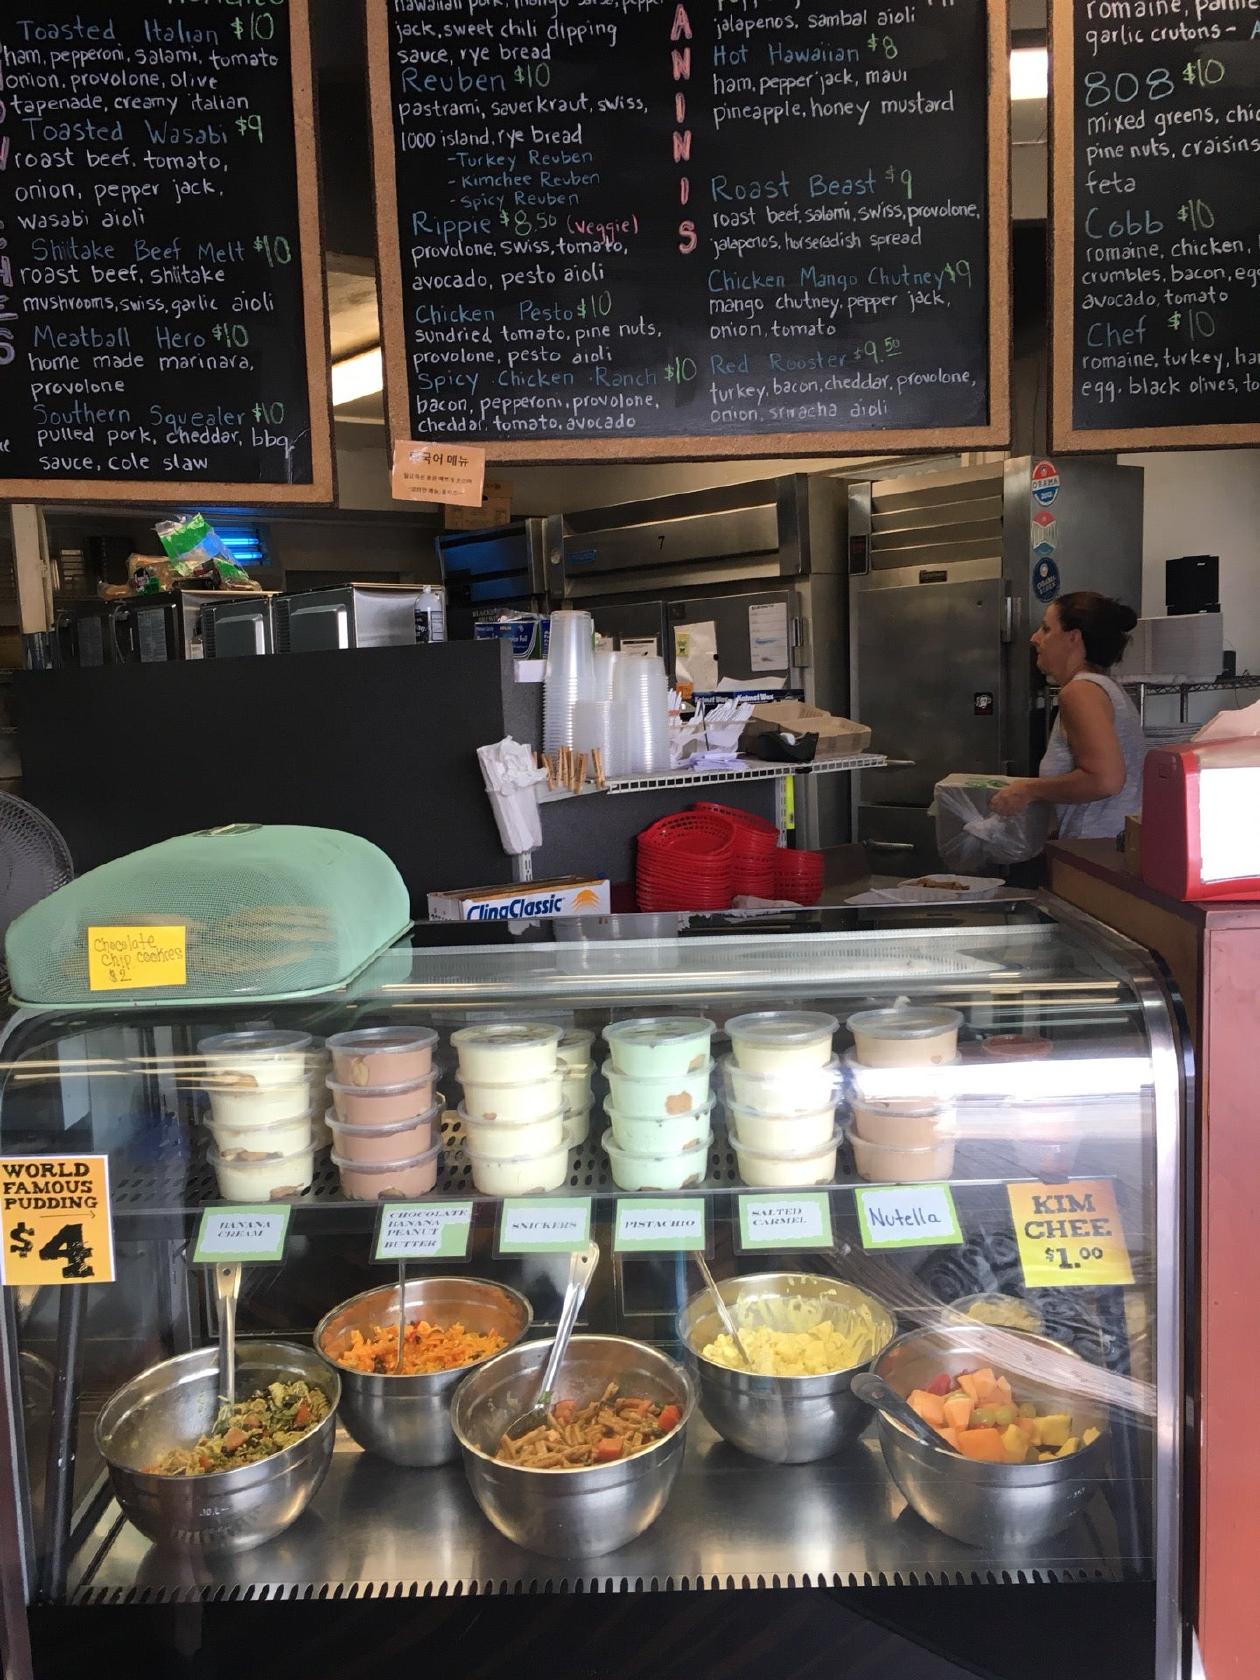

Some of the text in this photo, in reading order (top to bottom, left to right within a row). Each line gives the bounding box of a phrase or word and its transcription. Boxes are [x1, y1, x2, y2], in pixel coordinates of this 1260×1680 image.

[808, 6, 915, 28] sambal aioli
[16, 12, 274, 45] Toasted Italian $10
[444, 19, 617, 49] sweet chili dipping
[714, 33, 898, 66] Hot Hawaiian $8
[1086, 24, 1144, 56] garlic
[209, 48, 278, 70] tomato
[460, 47, 489, 66] rye
[499, 42, 550, 60] bread
[171, 71, 217, 89] olive
[402, 62, 550, 92] Reuben $10
[866, 69, 906, 85] maui
[1085, 59, 1225, 107] 808 $10
[114, 97, 177, 115] creamy
[192, 93, 248, 111] italian
[399, 96, 647, 125] pastrami, swiss,
[810, 90, 954, 125] honey mustard
[22, 115, 263, 144] Toasted Wasabi $9
[1088, 109, 1145, 135] mixed
[402, 123, 582, 151] 1000 rye bread
[15, 147, 75, 168] roast
[529, 150, 592, 165] Reuben
[1086, 143, 1124, 166] pine
[540, 171, 599, 187] Reuben
[712, 165, 912, 202] Roast Beast $9
[1085, 170, 1135, 194] feta
[94, 184, 159, 206] pepper
[515, 191, 578, 205] Reuben
[18, 207, 144, 229] wasabi aioli
[413, 209, 556, 246] Rippie $8.50
[713, 207, 756, 228] roast
[1085, 199, 1214, 239] Cobb $10
[870, 226, 921, 251] spread
[134, 235, 291, 267] Beef Melt $10
[20, 265, 80, 284] roast
[412, 262, 603, 290] avocado, pesto aioli
[708, 260, 971, 292] Chicken Mango Chutney $9
[172, 291, 273, 318] garlic aioli
[1164, 286, 1228, 305] tomato
[416, 291, 611, 325] Chicken Pesto $10
[710, 295, 898, 319] mango pepper
[34, 323, 248, 349] Meatball Hero $10
[415, 316, 661, 347] sundried pine nuts,
[771, 318, 836, 337] tomato
[1088, 315, 1146, 347] Chef
[28, 352, 253, 371] home made marinara,
[508, 346, 561, 368] pesto
[572, 345, 612, 364] aioli
[711, 352, 846, 375] Red Rooster
[418, 357, 696, 396] Spicy Chicken Ranch $10
[1130, 376, 1180, 395] black
[31, 379, 124, 402] provolone
[33, 400, 284, 434] Southern Squealer $10
[850, 399, 887, 418] aioli
[567, 413, 636, 430] avocado
[38, 427, 94, 447] pulled
[108, 453, 207, 471] cole slaw
[409, 451, 443, 465] 국어
[93, 933, 155, 954] Chocolate
[2, 1162, 90, 1178] WORLD
[3, 1180, 93, 1194] FAMOUS
[4, 1196, 98, 1210] PUDDING
[389, 1209, 469, 1219] CHOCOLATE
[751, 1208, 802, 1216] SALTED
[1032, 1194, 1096, 1215] KIM
[219, 1221, 271, 1230] BANANA
[511, 1221, 578, 1230] SNICKERS
[624, 1220, 696, 1229] PISTACHIO
[752, 1217, 808, 1226] CARMEL
[868, 1207, 941, 1227] Nutella
[217, 1230, 264, 1238] CREAM
[386, 1228, 439, 1237] PEANUT
[1024, 1218, 1112, 1240] CHEE
[383, 1240, 438, 1248] BUTTER
